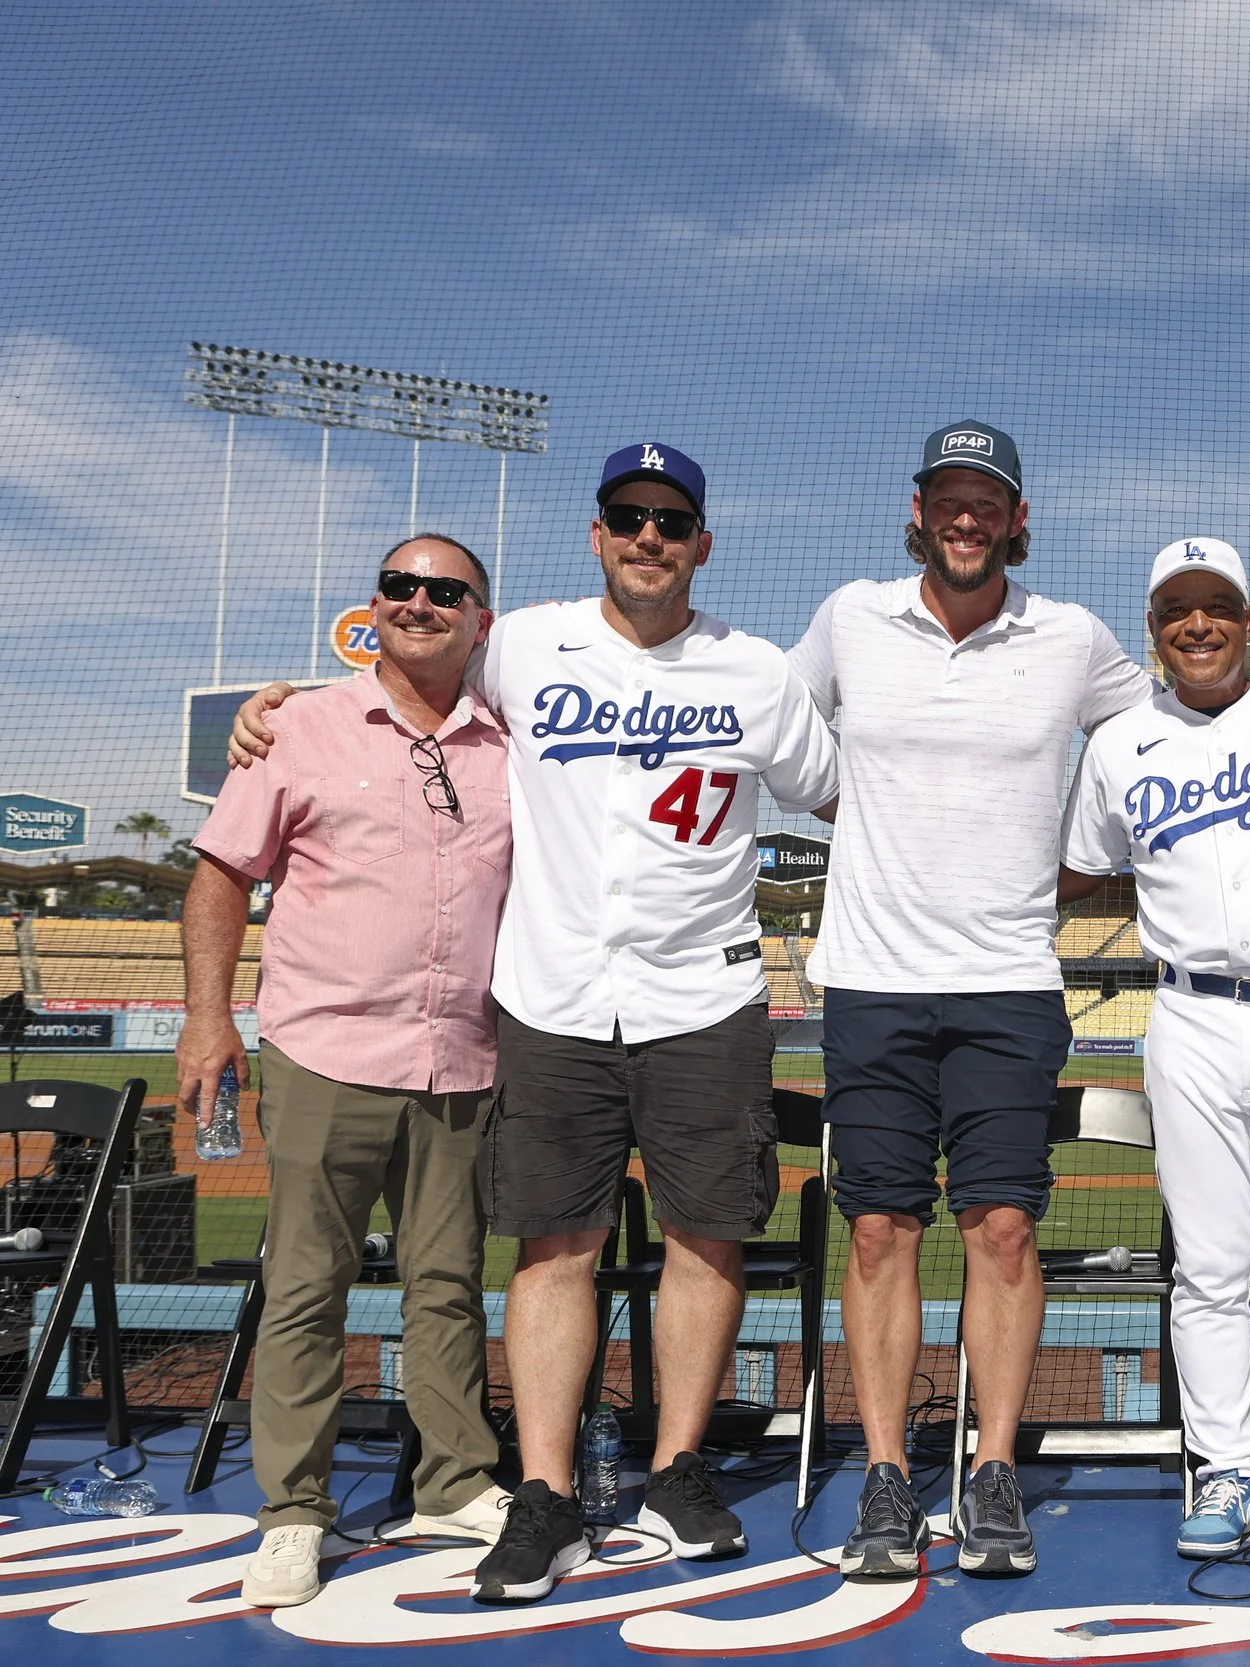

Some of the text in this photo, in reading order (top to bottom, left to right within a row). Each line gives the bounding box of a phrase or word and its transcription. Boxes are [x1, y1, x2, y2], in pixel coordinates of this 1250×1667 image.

[948, 436, 987, 449] PP4P
[640, 444, 664, 471] LA
[1184, 542, 1206, 561] LA
[531, 683, 743, 771] Dodgers
[649, 767, 739, 846] 47
[6, 807, 77, 829] Security
[6, 823, 67, 841] Benefit
[779, 851, 825, 865] Health
